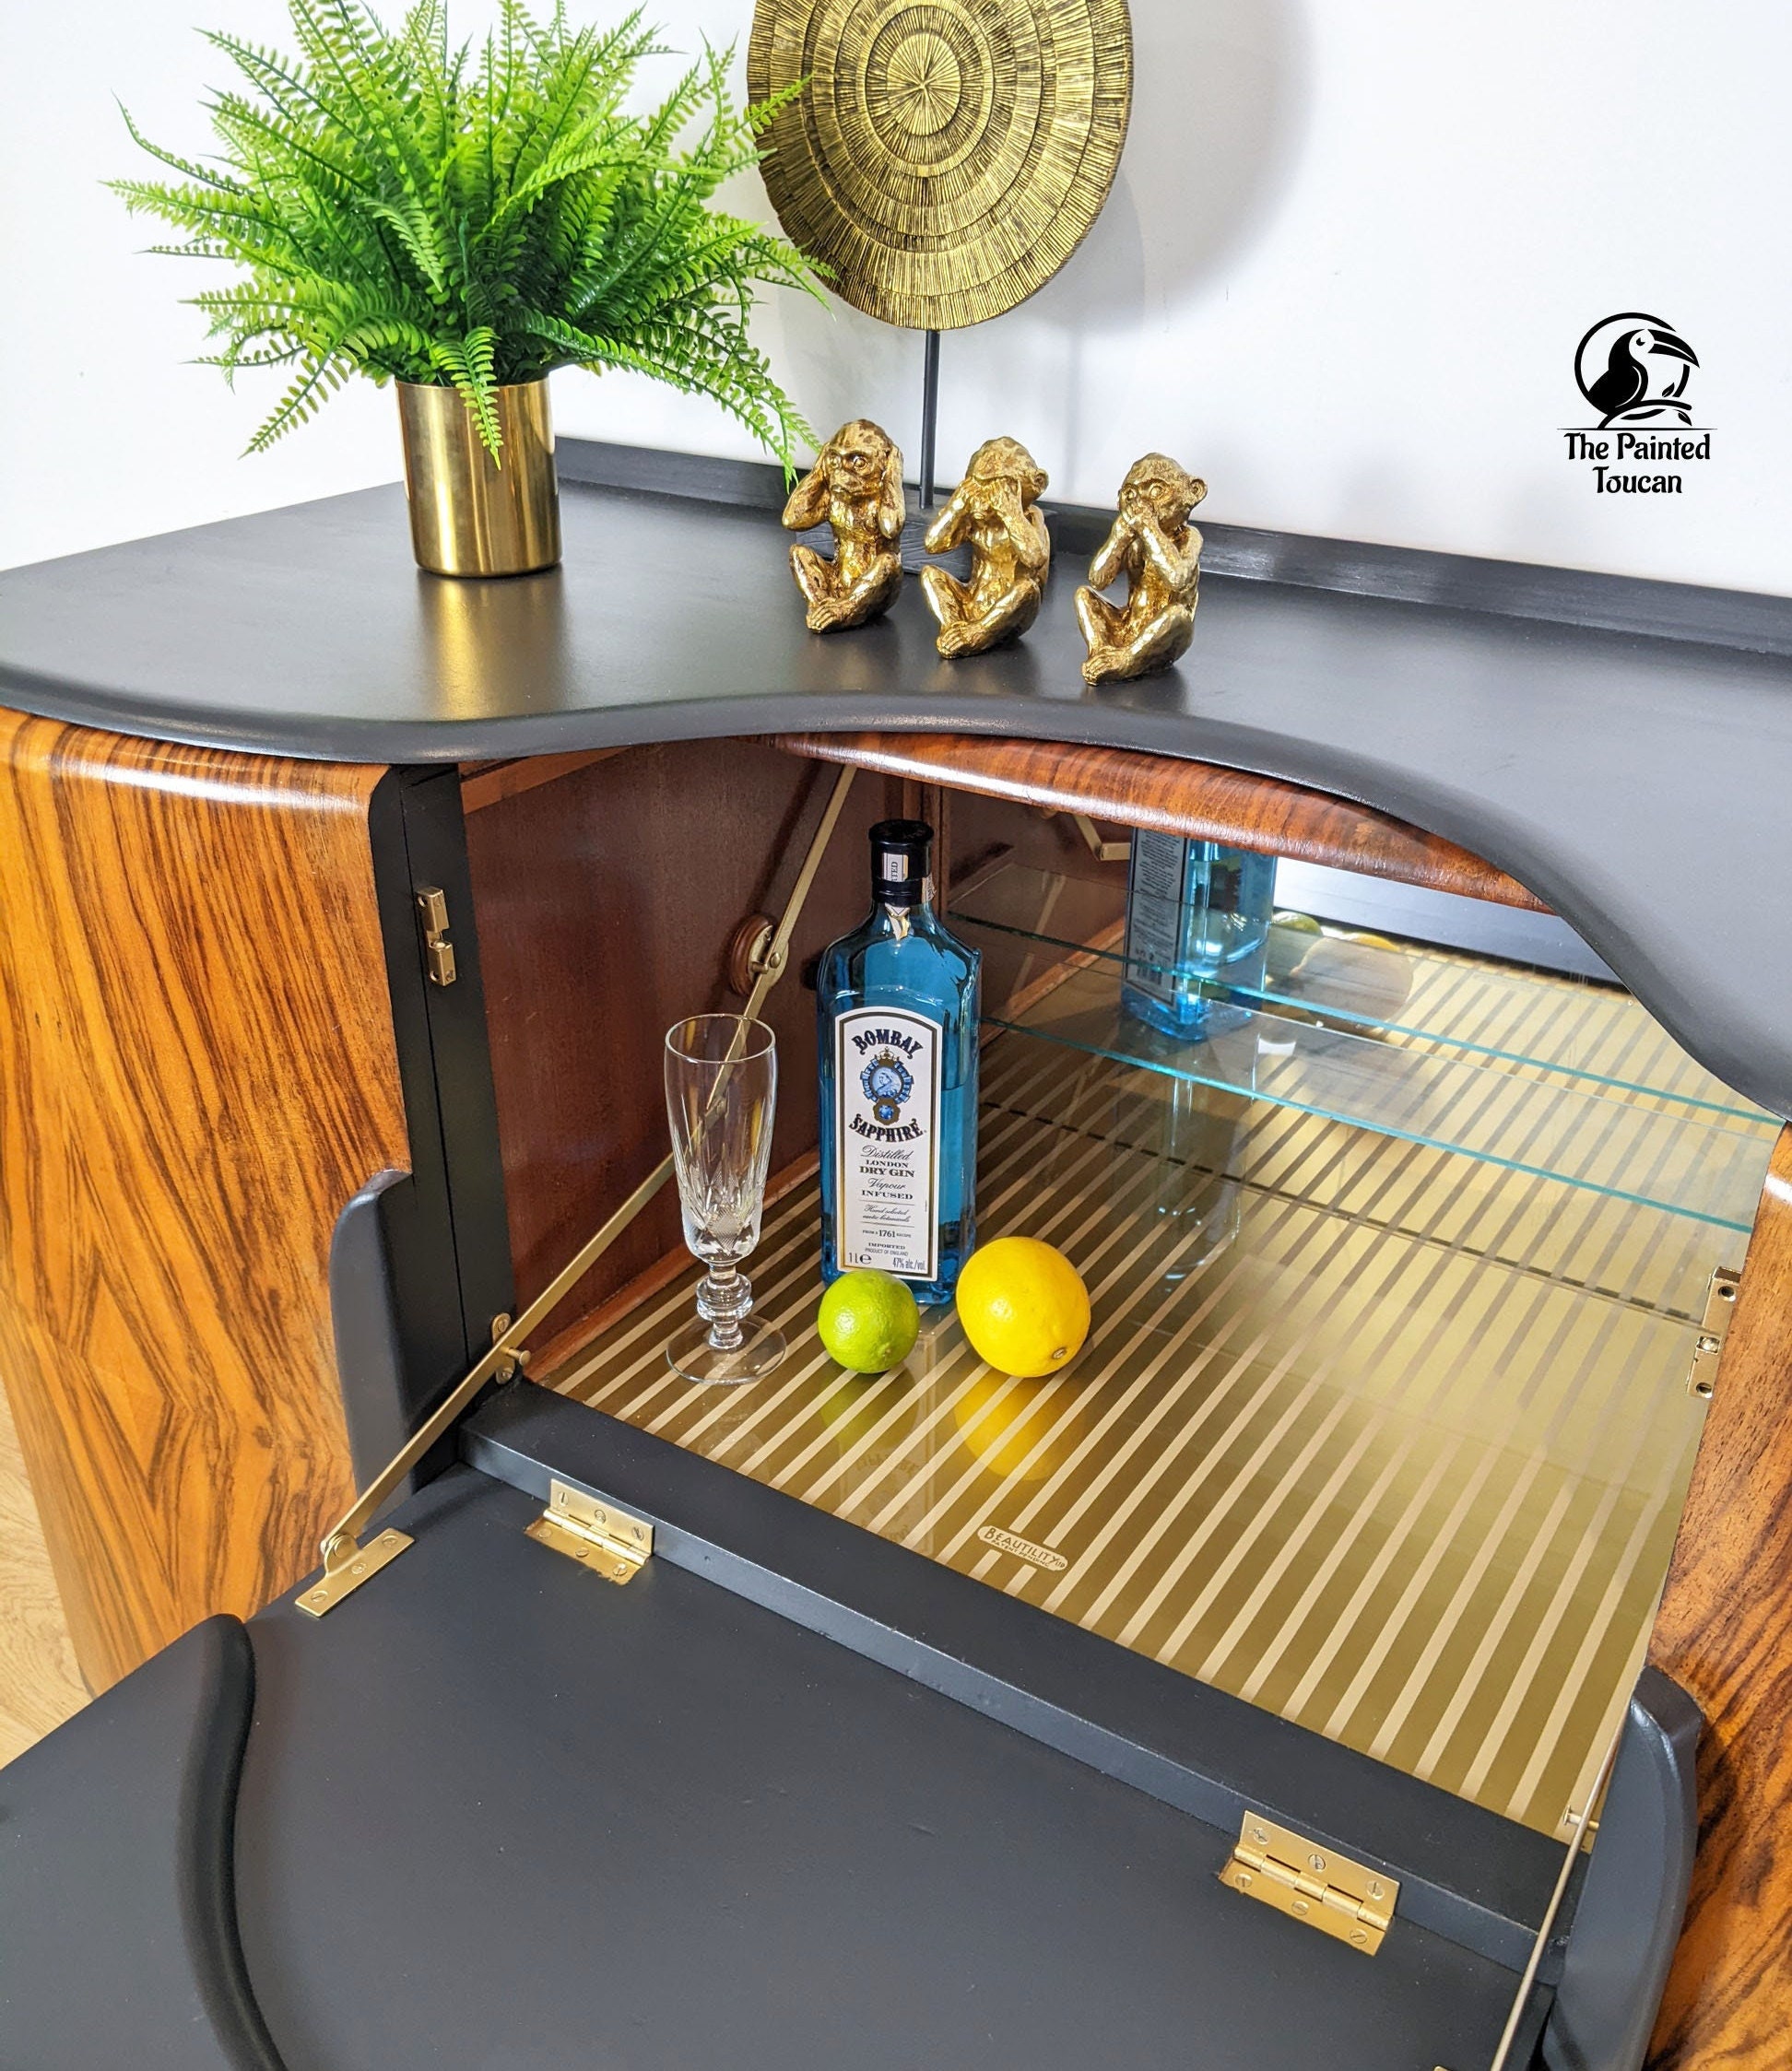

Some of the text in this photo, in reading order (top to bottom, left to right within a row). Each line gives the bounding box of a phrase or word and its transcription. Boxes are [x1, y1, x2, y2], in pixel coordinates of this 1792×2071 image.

[852, 1029, 924, 1059] BOMBAY
[848, 1113, 923, 1143] SAPPHIRE
[860, 1145, 914, 1160] Distilled
[865, 1159, 909, 1168] LONDON
[859, 1166, 915, 1178] DRY GIN
[867, 1178, 905, 1191] Vapour
[861, 1190, 914, 1200] INFUSED
[878, 1230, 896, 1238] 1761
[892, 1257, 904, 1269] 47%
[984, 1526, 1059, 1565] BEAUTILITY
